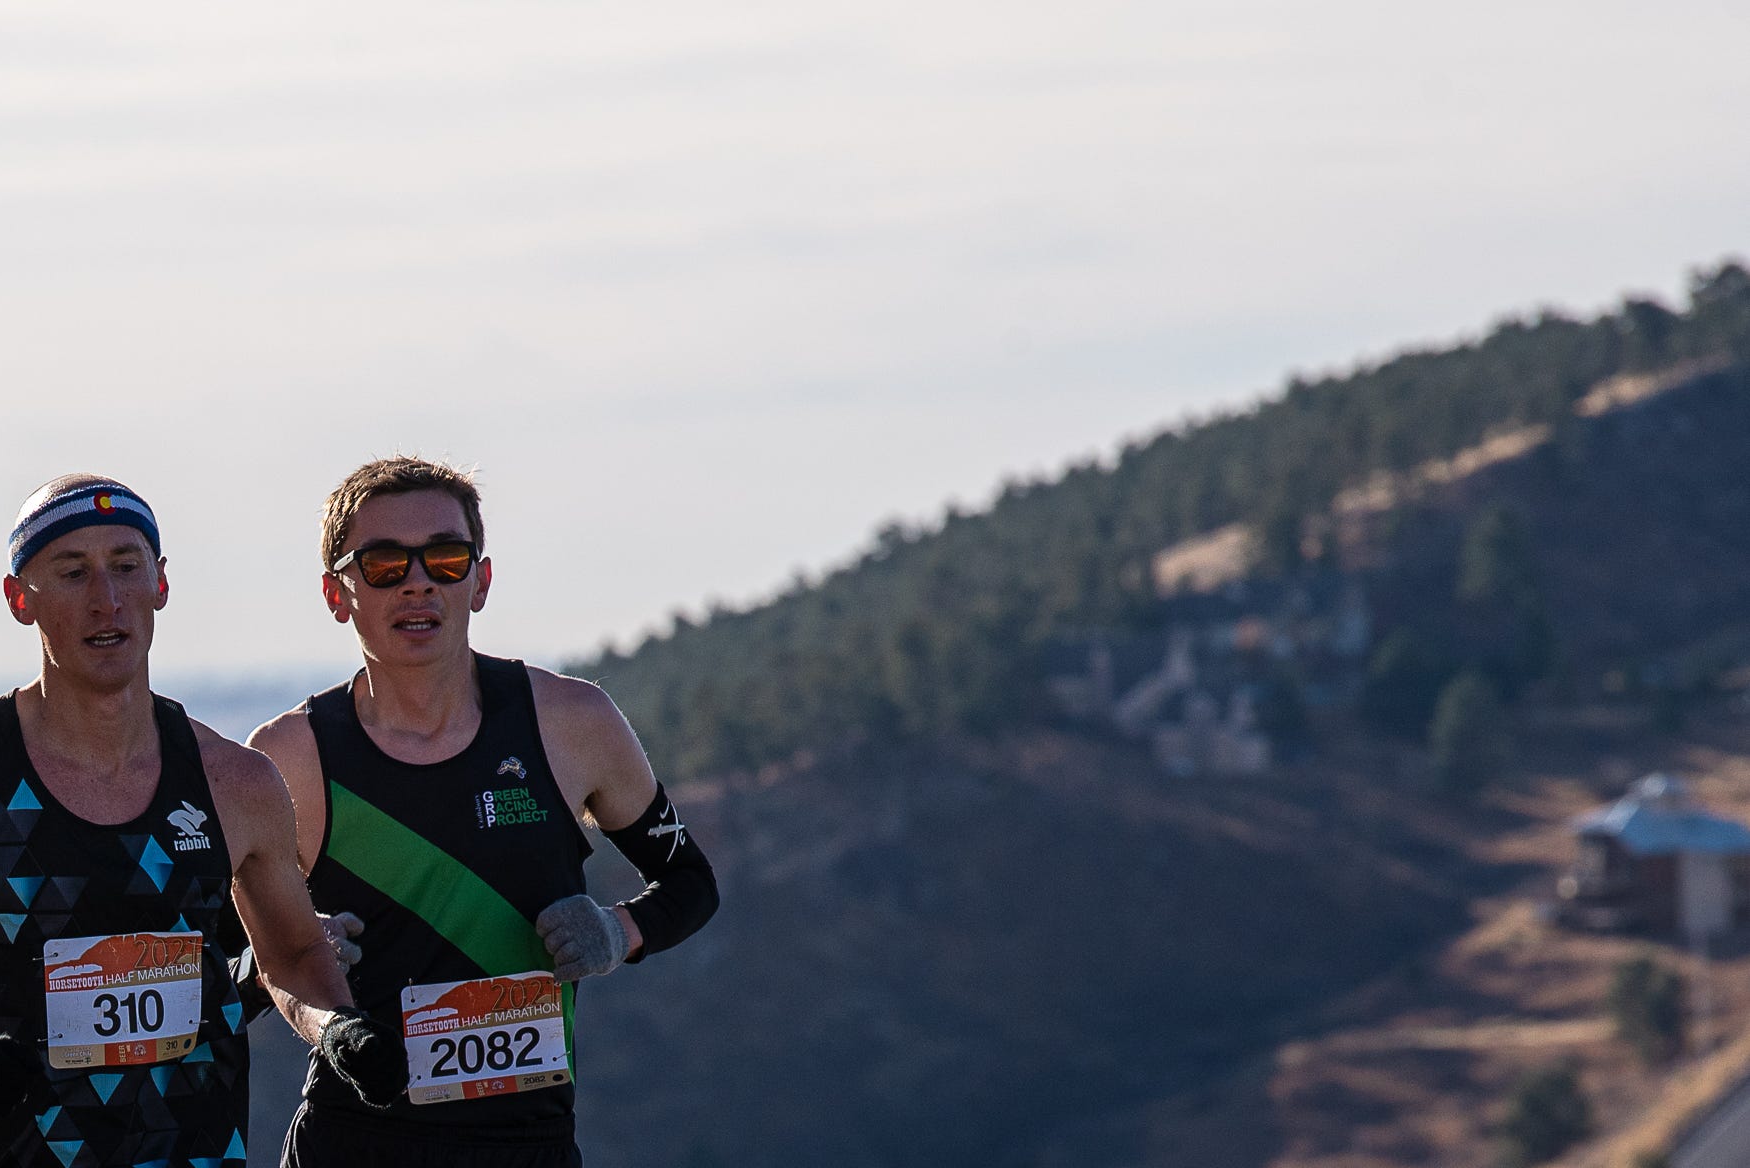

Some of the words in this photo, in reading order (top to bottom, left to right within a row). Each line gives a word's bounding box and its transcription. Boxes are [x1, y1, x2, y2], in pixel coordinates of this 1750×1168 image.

[482, 788, 530, 803] GREEN
[485, 799, 538, 815] RACING
[487, 810, 548, 828] PROJECT
[173, 836, 211, 851] rabbit
[133, 937, 198, 969] 2021
[49, 975, 104, 991] HORSETOOTH
[105, 970, 136, 985] HALF
[137, 963, 200, 982] MARATHON
[93, 989, 165, 1037] 310
[406, 1018, 460, 1036] HORSETOOTH
[461, 1013, 492, 1027] HALF
[494, 1001, 561, 1022] MARATHON
[430, 1026, 543, 1078] 2082
[523, 1075, 546, 1085] 2082
